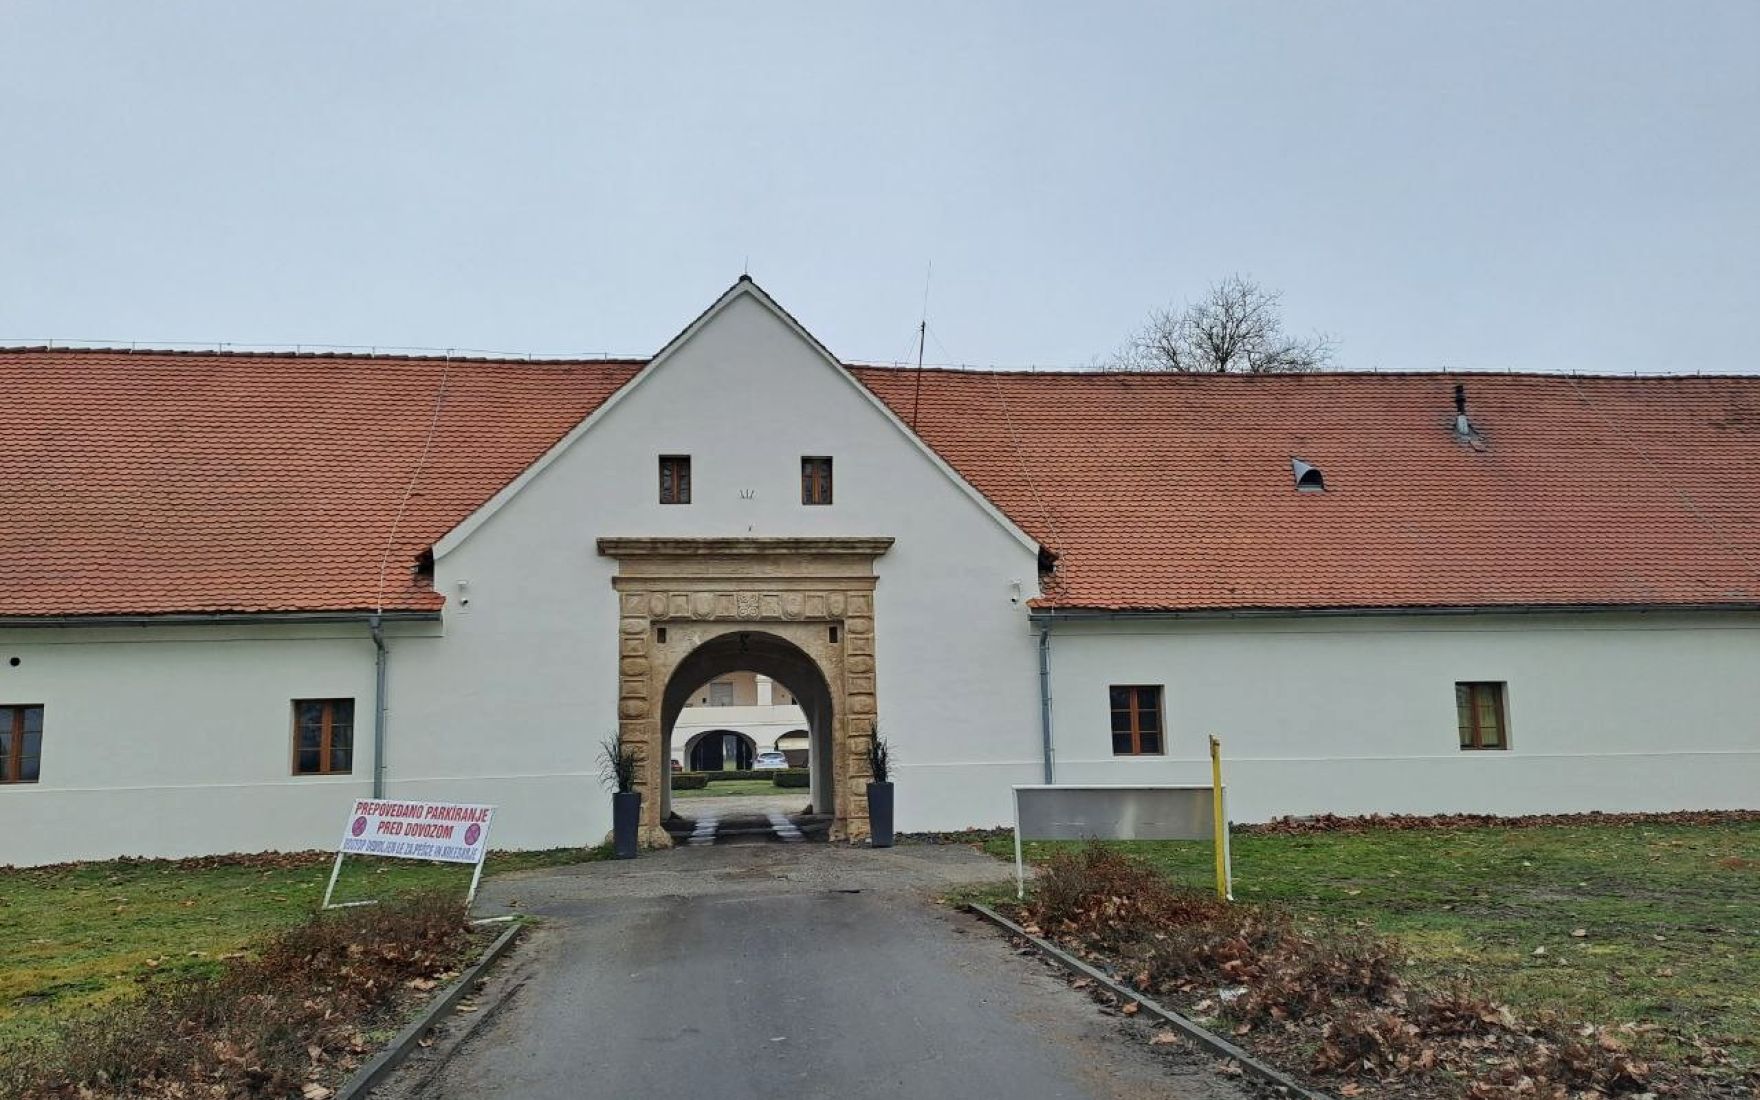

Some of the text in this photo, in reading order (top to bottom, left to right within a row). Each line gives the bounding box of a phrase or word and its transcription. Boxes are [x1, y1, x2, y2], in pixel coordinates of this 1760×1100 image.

[355, 802, 489, 822] PREPOVEDANO PARKIRANJE
[377, 822, 454, 839] PRED DOVOZOM
